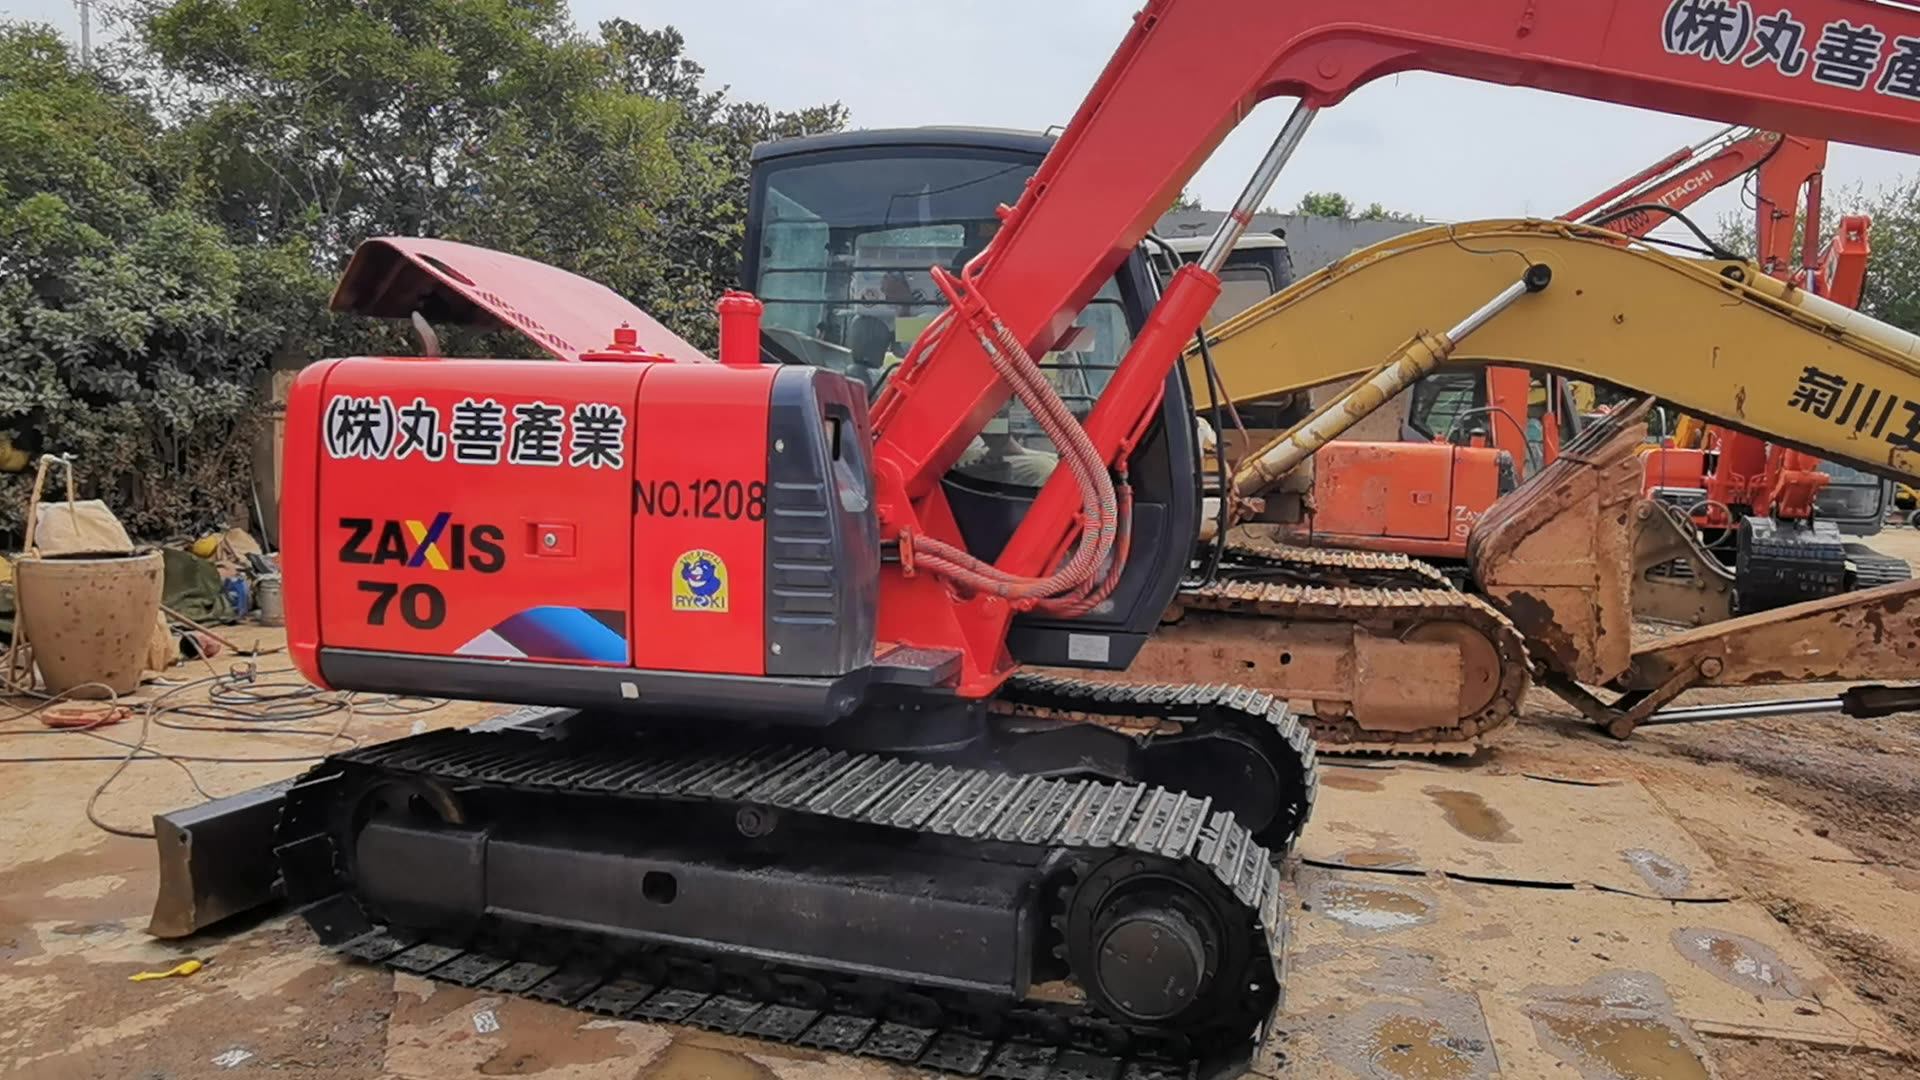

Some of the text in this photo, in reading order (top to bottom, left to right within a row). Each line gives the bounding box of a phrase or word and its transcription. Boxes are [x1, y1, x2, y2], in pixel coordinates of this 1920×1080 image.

[632, 479, 767, 521] NO.1208
[338, 511, 506, 574] ZAXIS
[357, 579, 447, 630] 70
[676, 594, 725, 609] RYOKI
